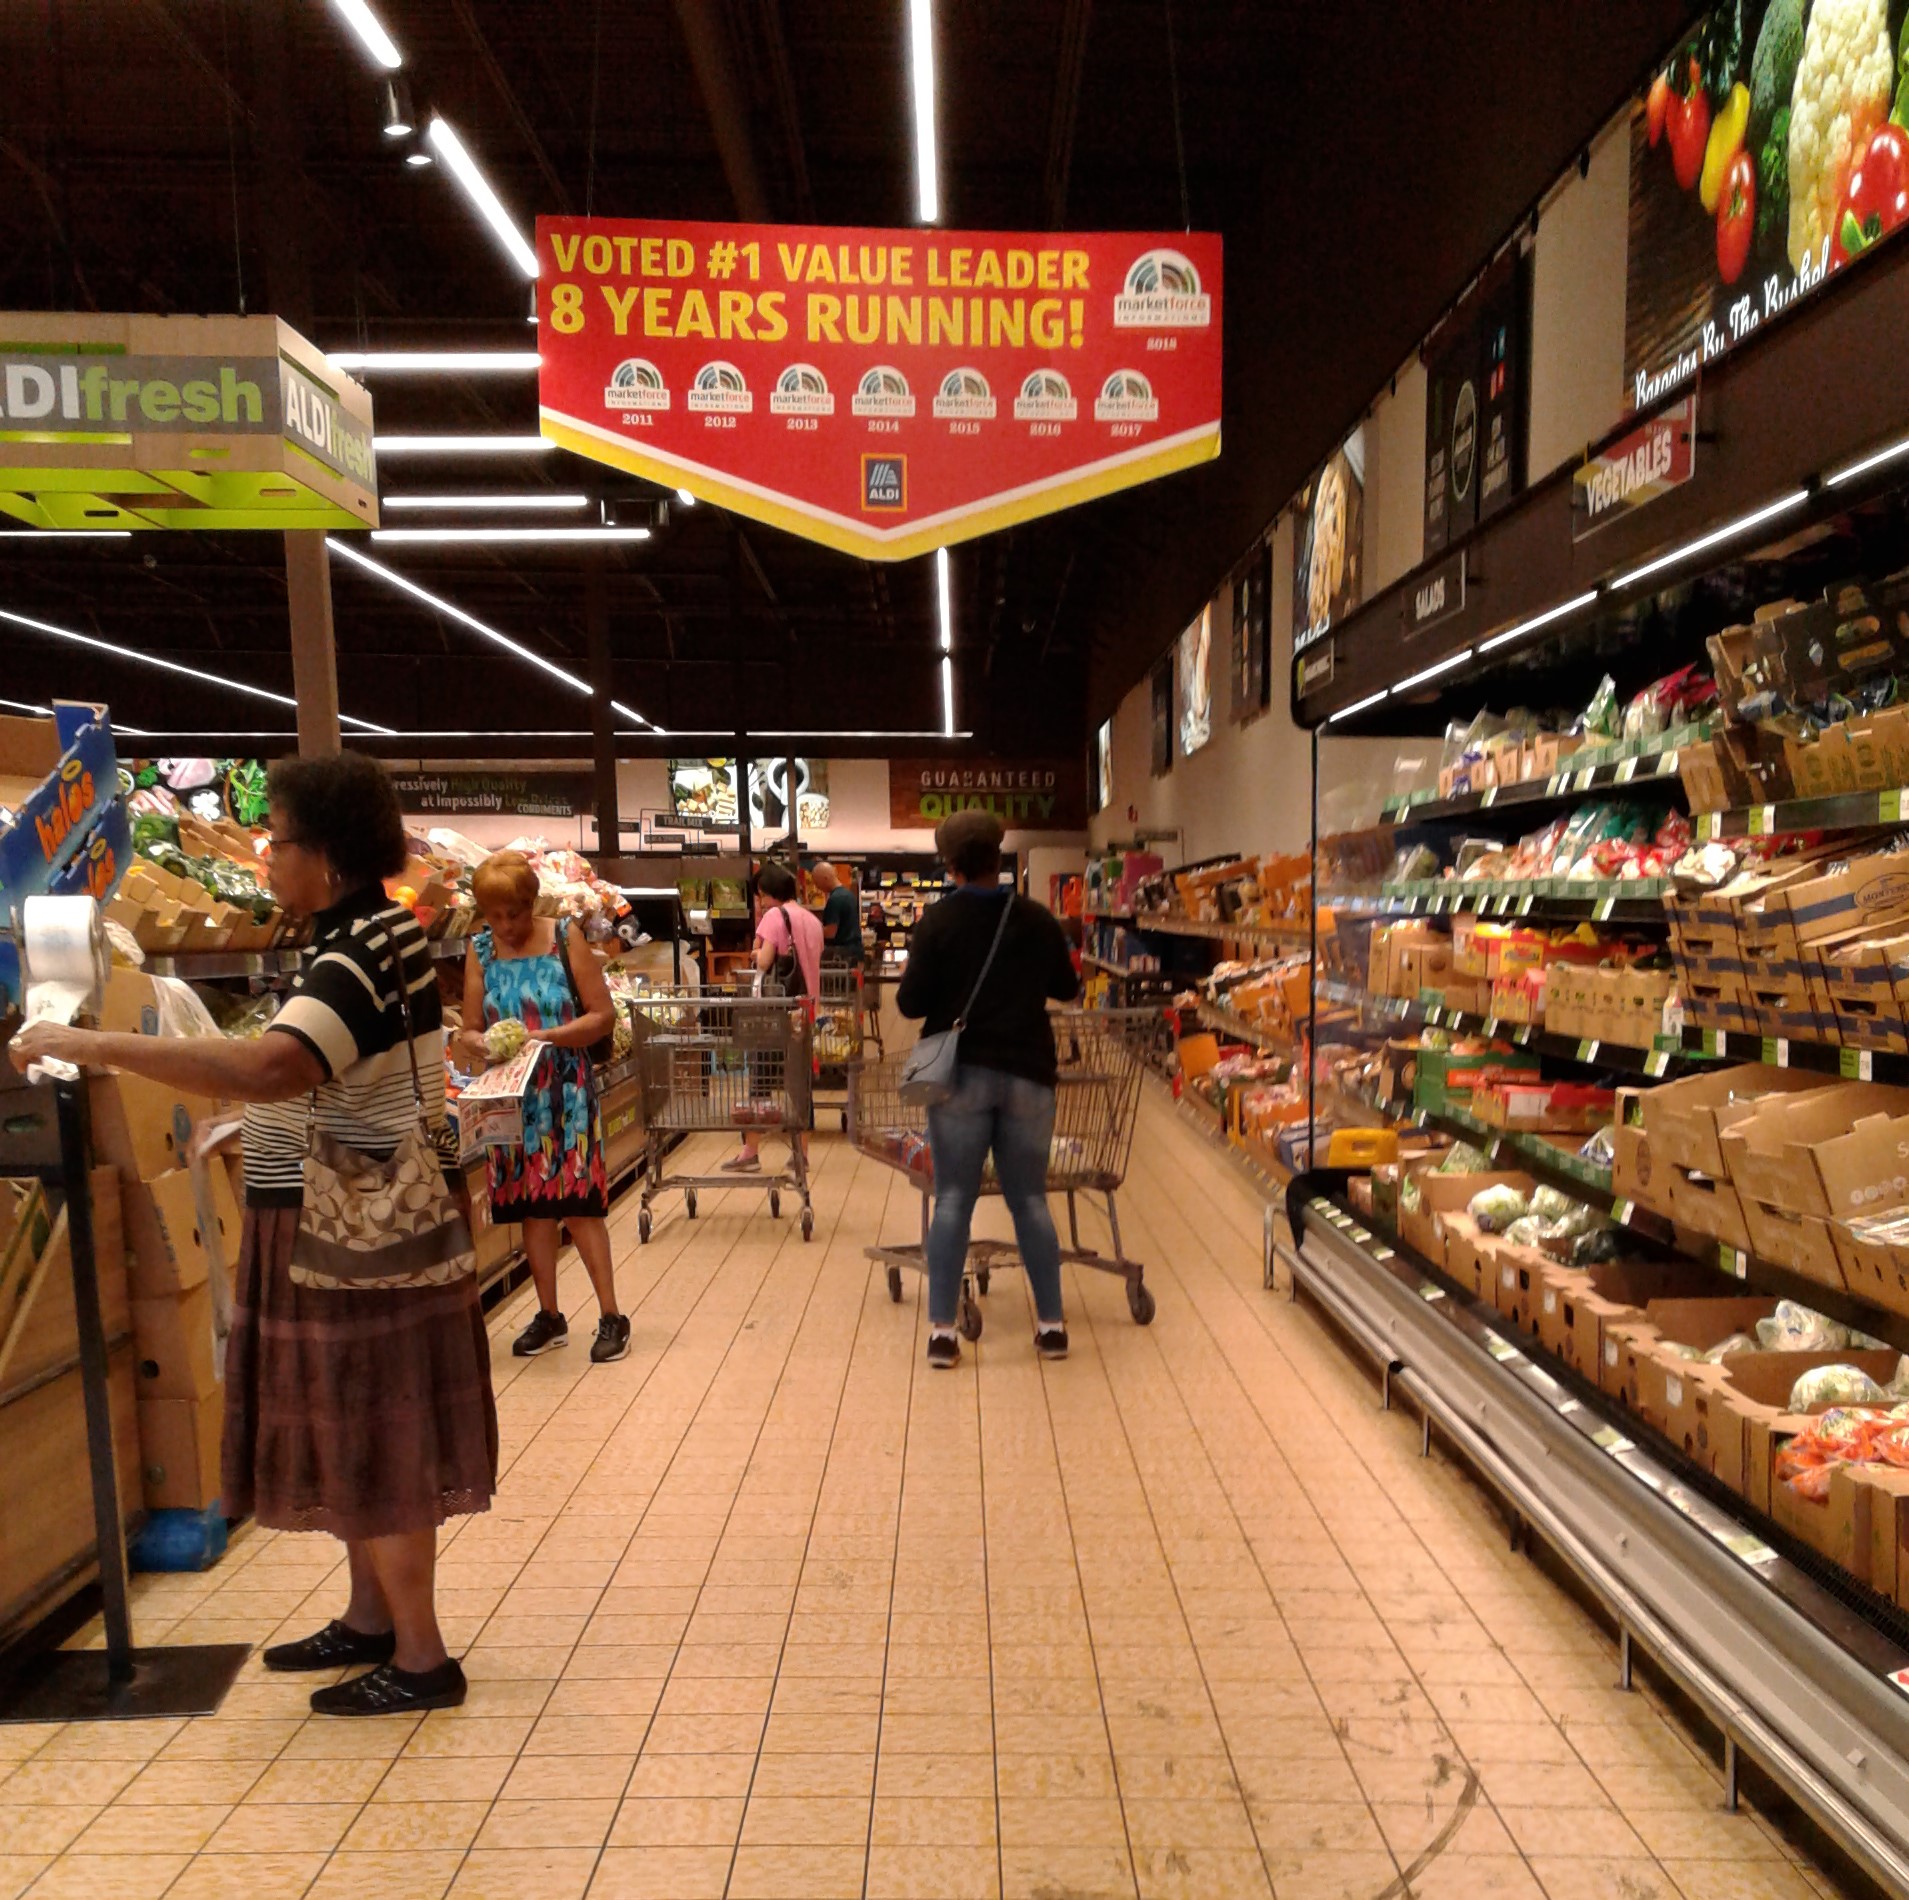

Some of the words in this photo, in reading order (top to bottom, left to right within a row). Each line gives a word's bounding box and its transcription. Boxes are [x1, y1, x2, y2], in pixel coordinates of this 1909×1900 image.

[550, 234, 695, 277] VOTED
[707, 240, 760, 281] #1
[777, 242, 913, 286] VALUE
[927, 247, 1090, 290] LEADER
[550, 284, 585, 335] 8
[600, 286, 788, 342] YEARS
[807, 293, 1084, 350] RUNNING!
[0, 365, 263, 424] DIfresh
[608, 388, 667, 400] marketforce
[690, 391, 749, 402] marketforce
[773, 394, 831, 404] marketforce
[855, 396, 912, 406] marketforce
[622, 413, 653, 425] 2011
[704, 415, 737, 428] 2012
[787, 418, 818, 430] 2013
[868, 420, 900, 432] 2014
[949, 422, 980, 434] 2015
[1110, 424, 1142, 437] 2017
[1586, 429, 1672, 517] VEGETABLES
[869, 488, 899, 500] ALDI
[921, 770, 1056, 787] GUARANTEED
[393, 777, 448, 794] ressively
[421, 796, 433, 808] at
[437, 793, 502, 811] Impossibly
[920, 792, 1056, 820] QUALITY
[517, 802, 573, 816] CONDIMENTS
[664, 816, 685, 826] TRAIL
